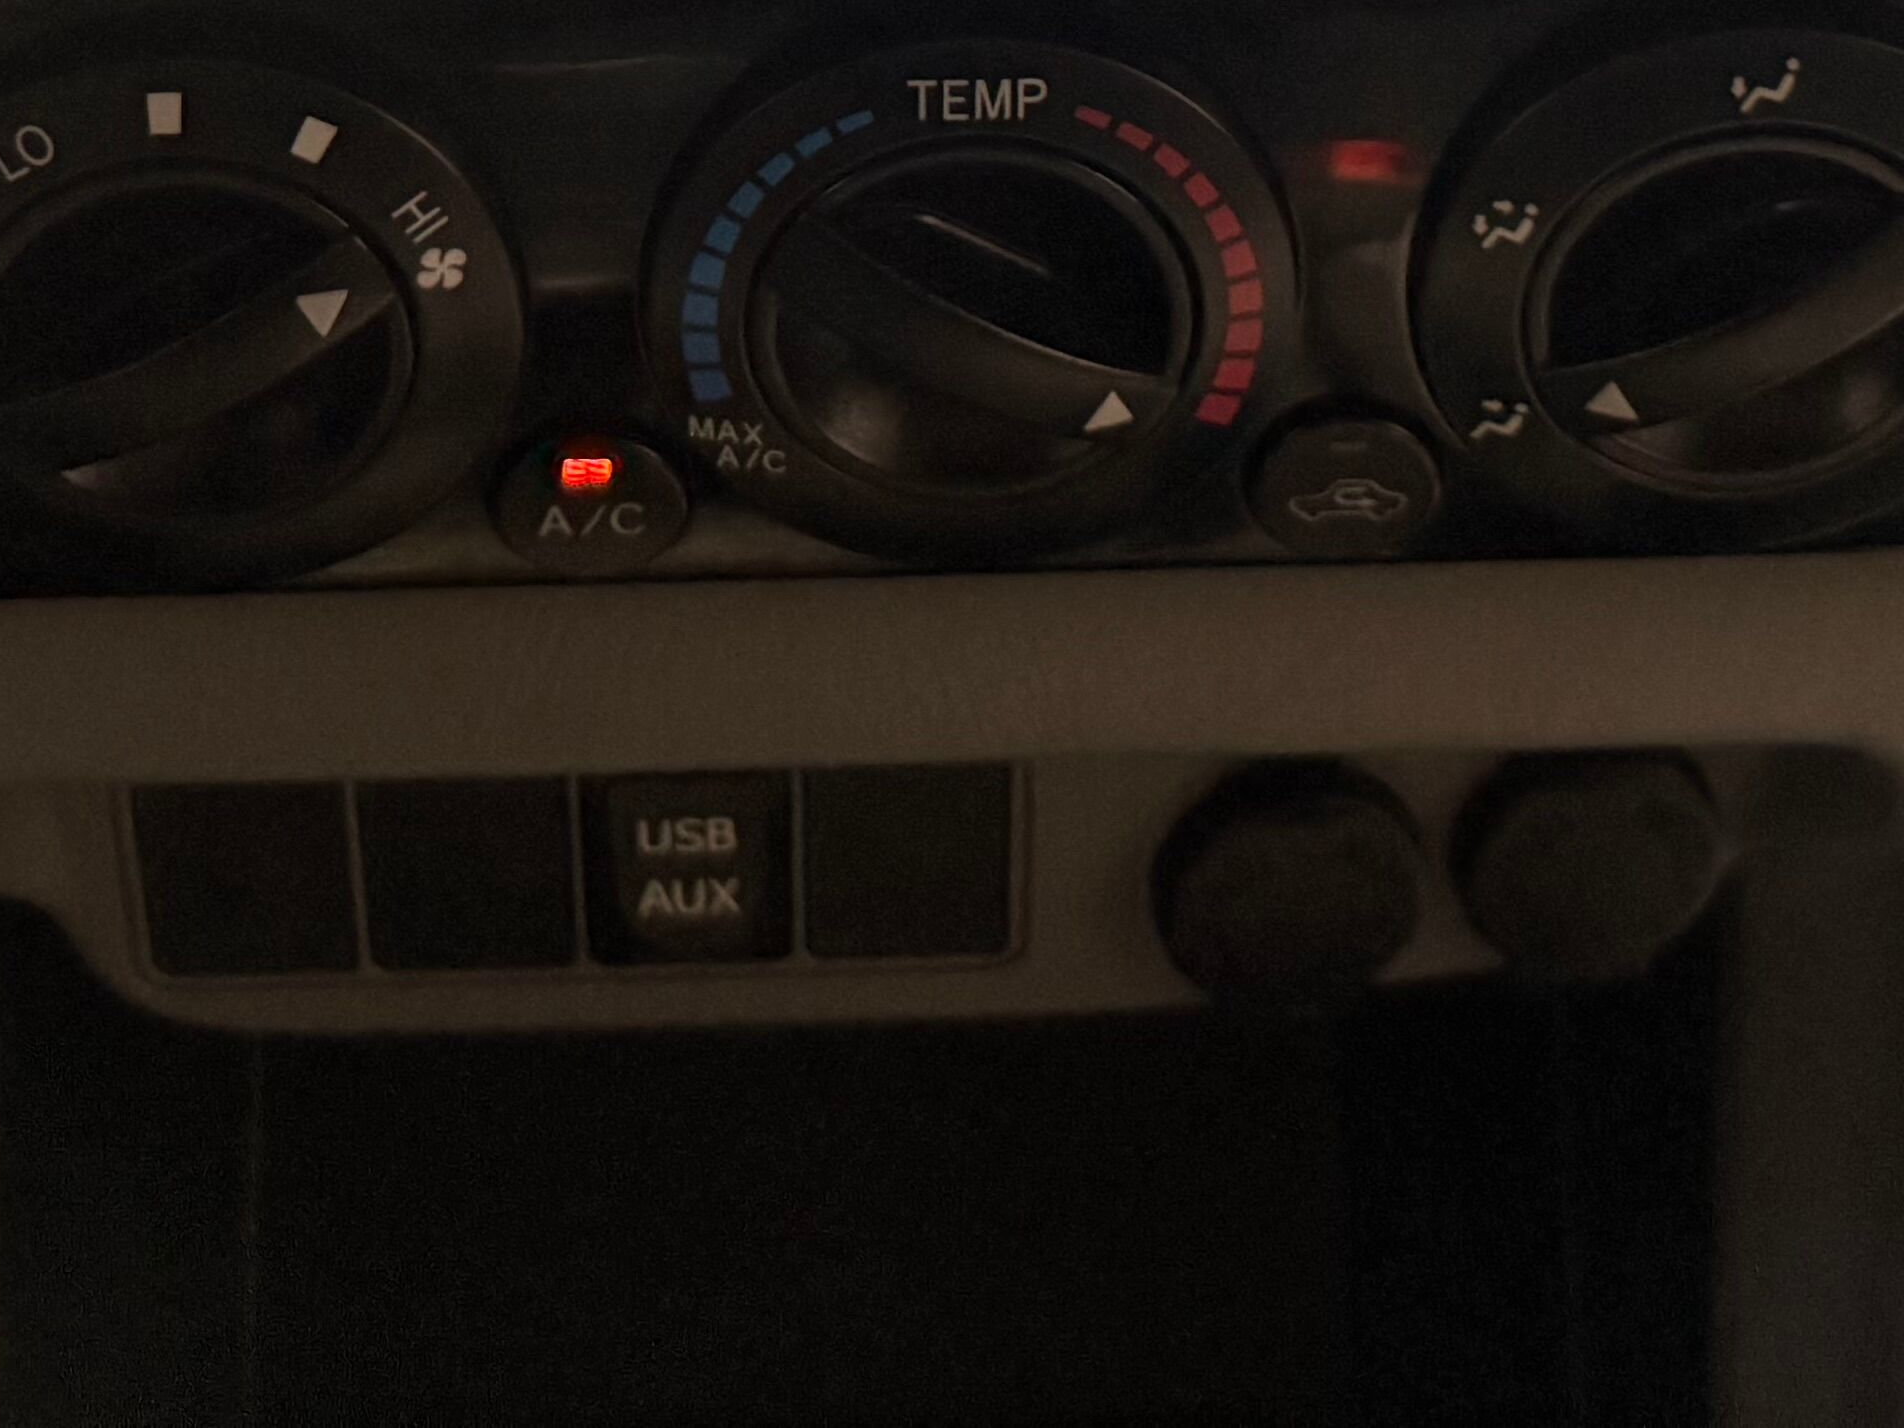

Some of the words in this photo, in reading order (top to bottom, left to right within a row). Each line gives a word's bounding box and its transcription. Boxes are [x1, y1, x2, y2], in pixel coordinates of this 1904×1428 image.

[906, 77, 1049, 121] TEMP
[391, 190, 449, 247] HI
[687, 415, 765, 446] MAX
[717, 441, 788, 475] A/C
[538, 501, 645, 538] A/C
[636, 817, 739, 855] USB
[637, 878, 741, 918] AUX
